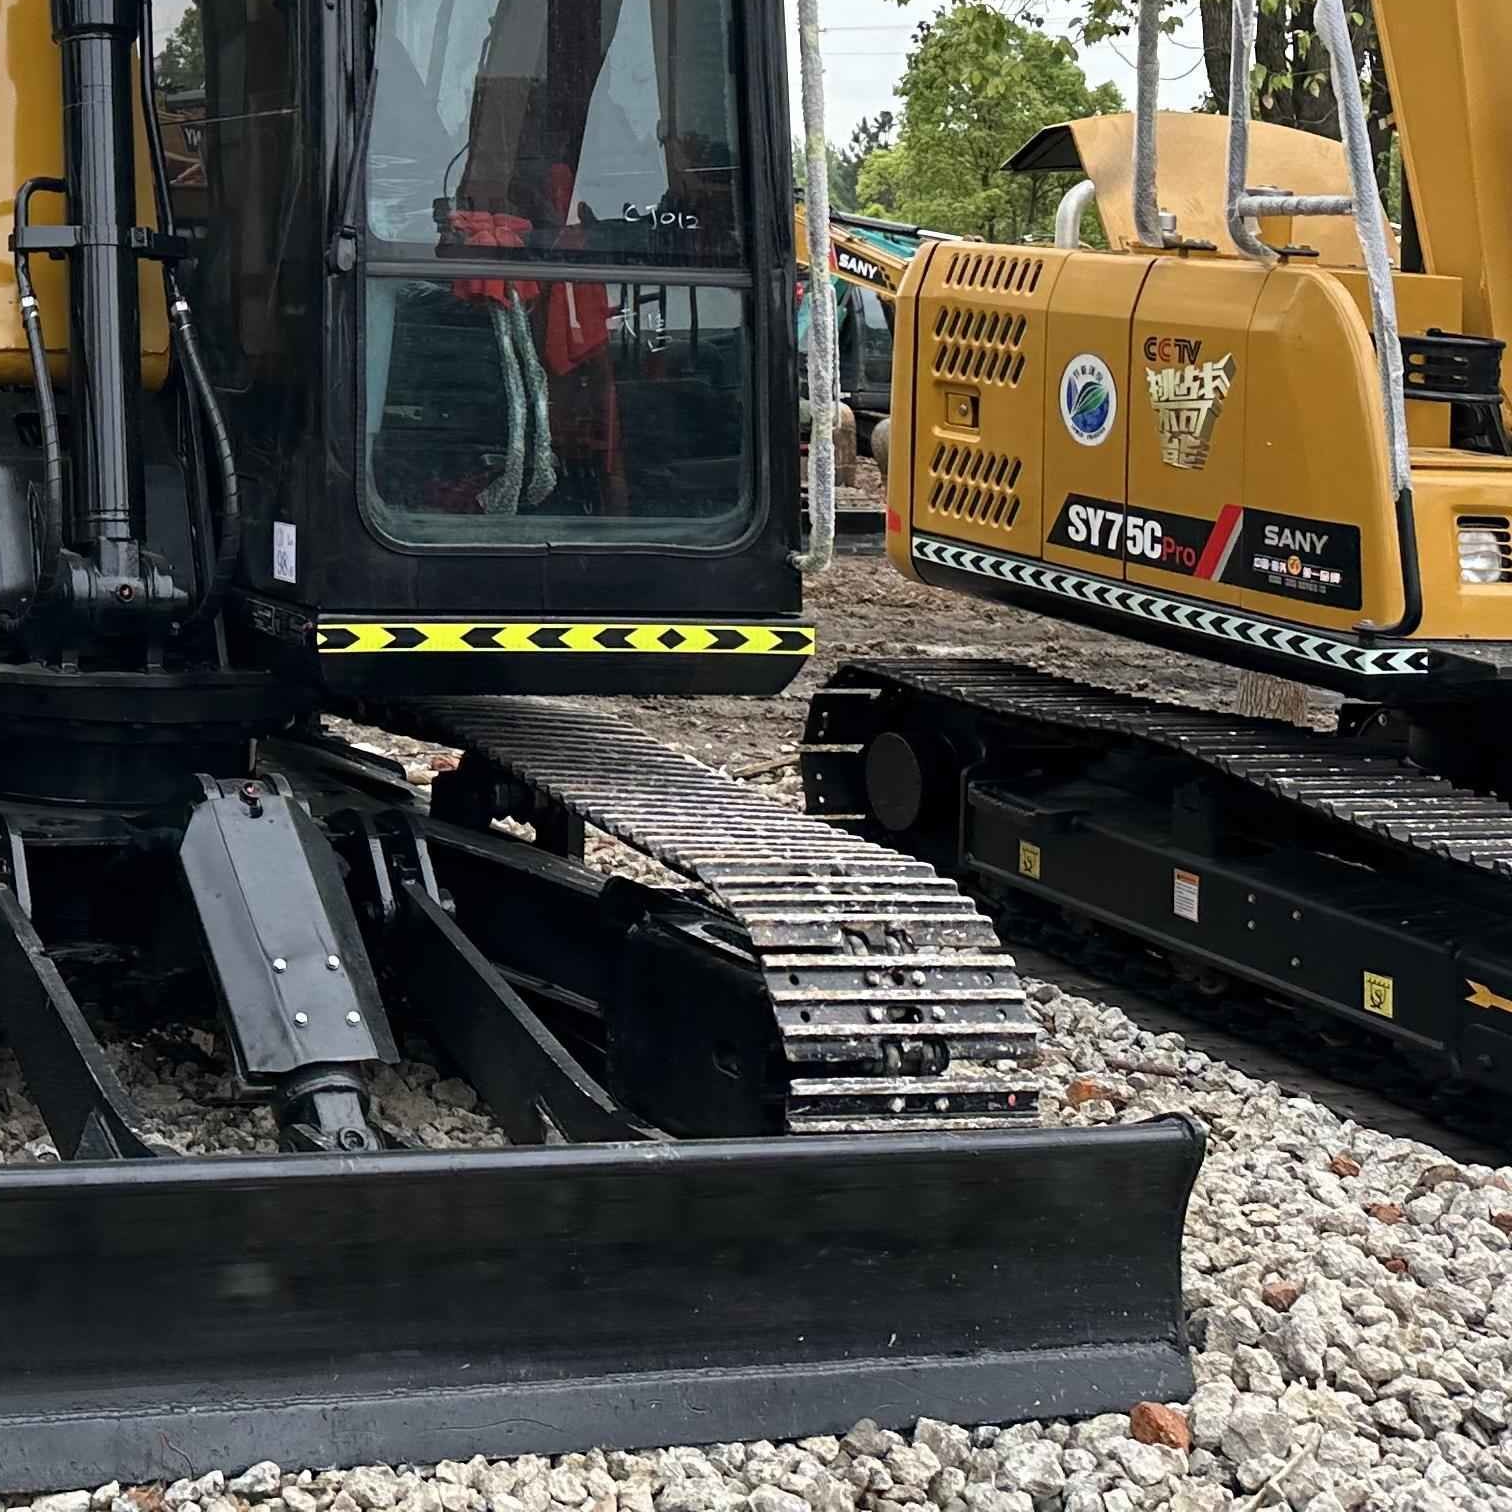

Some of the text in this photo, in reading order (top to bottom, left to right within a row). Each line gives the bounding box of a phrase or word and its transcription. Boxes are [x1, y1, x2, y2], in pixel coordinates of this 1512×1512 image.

[838, 253, 878, 279] SANY
[1144, 337, 1202, 364] CCTV
[1067, 504, 1196, 567] SY75C Pro
[1264, 525, 1328, 555] SANY
